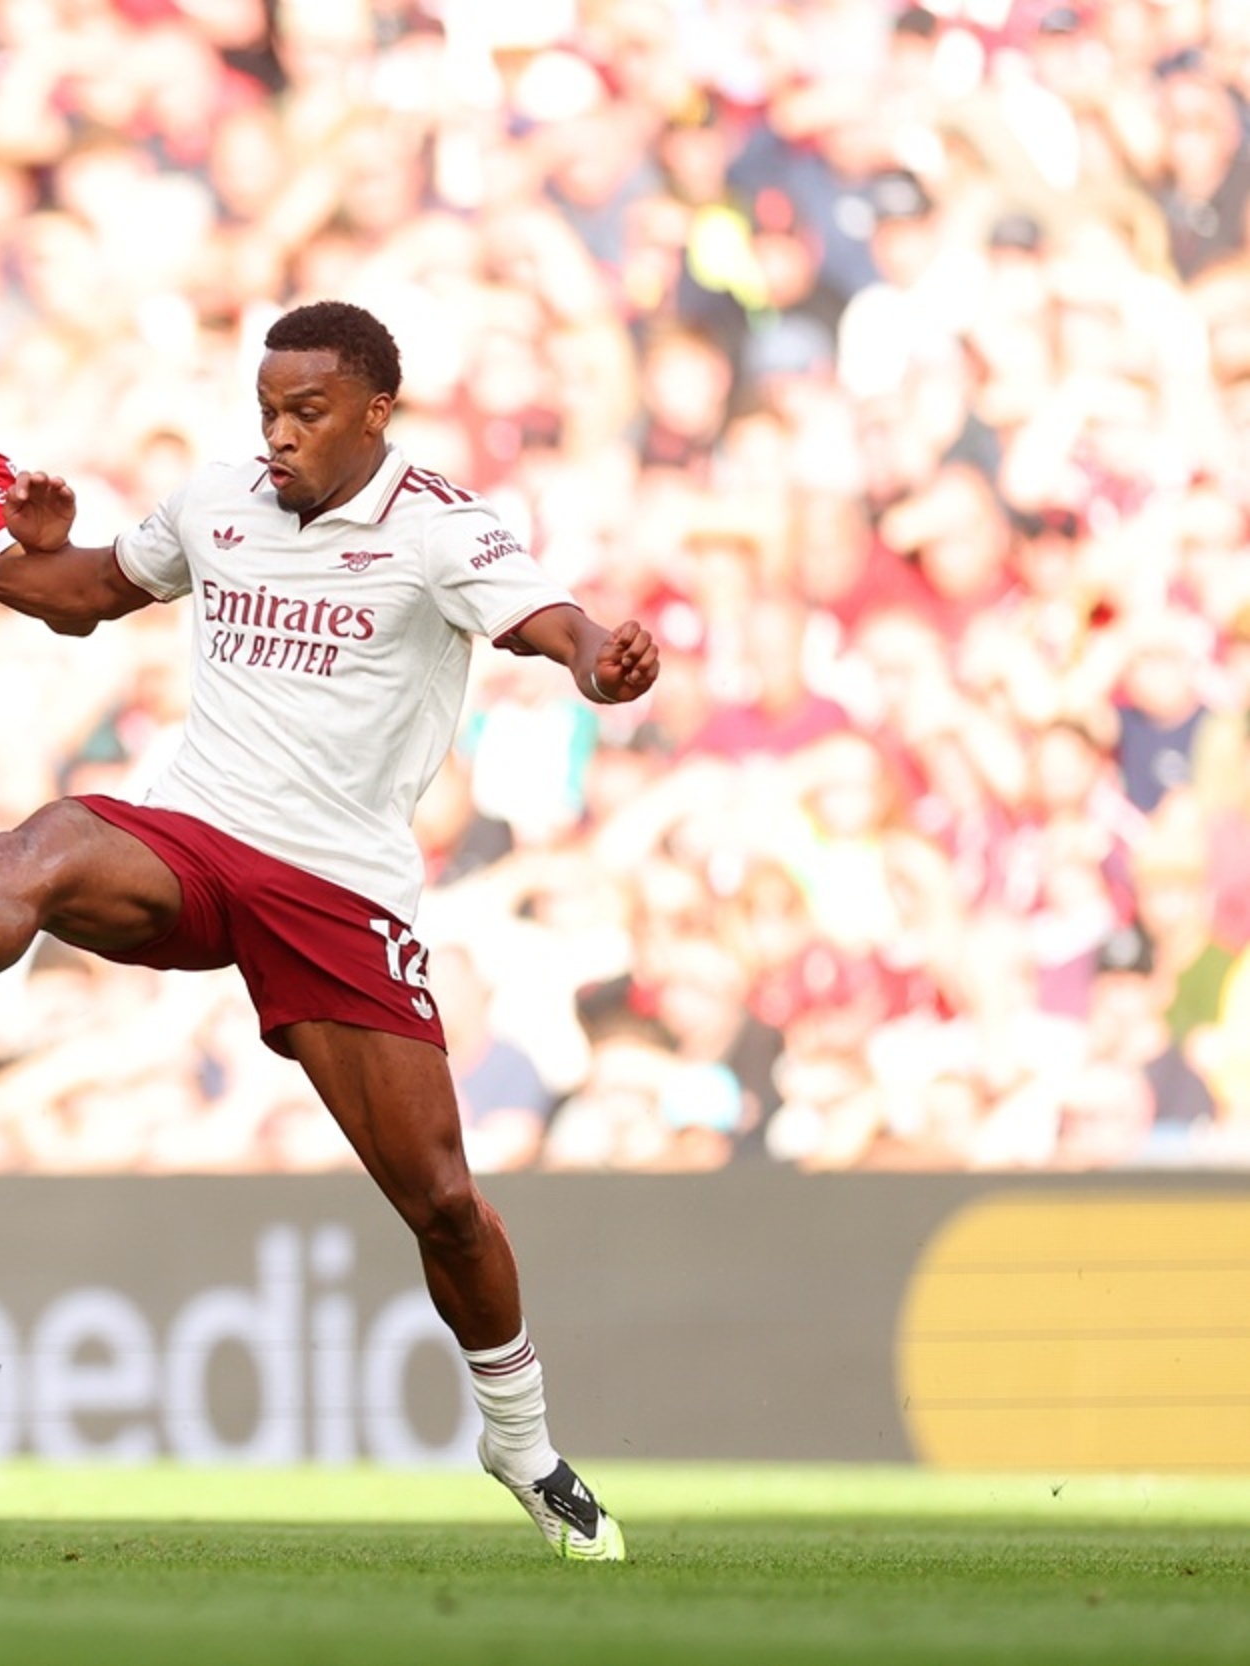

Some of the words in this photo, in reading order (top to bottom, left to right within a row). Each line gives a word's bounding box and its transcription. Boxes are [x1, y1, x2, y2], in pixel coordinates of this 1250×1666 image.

[202, 579, 375, 641] Emirates
[209, 629, 245, 663] FLY
[246, 635, 339, 677] BETTER
[369, 918, 429, 988] 12
